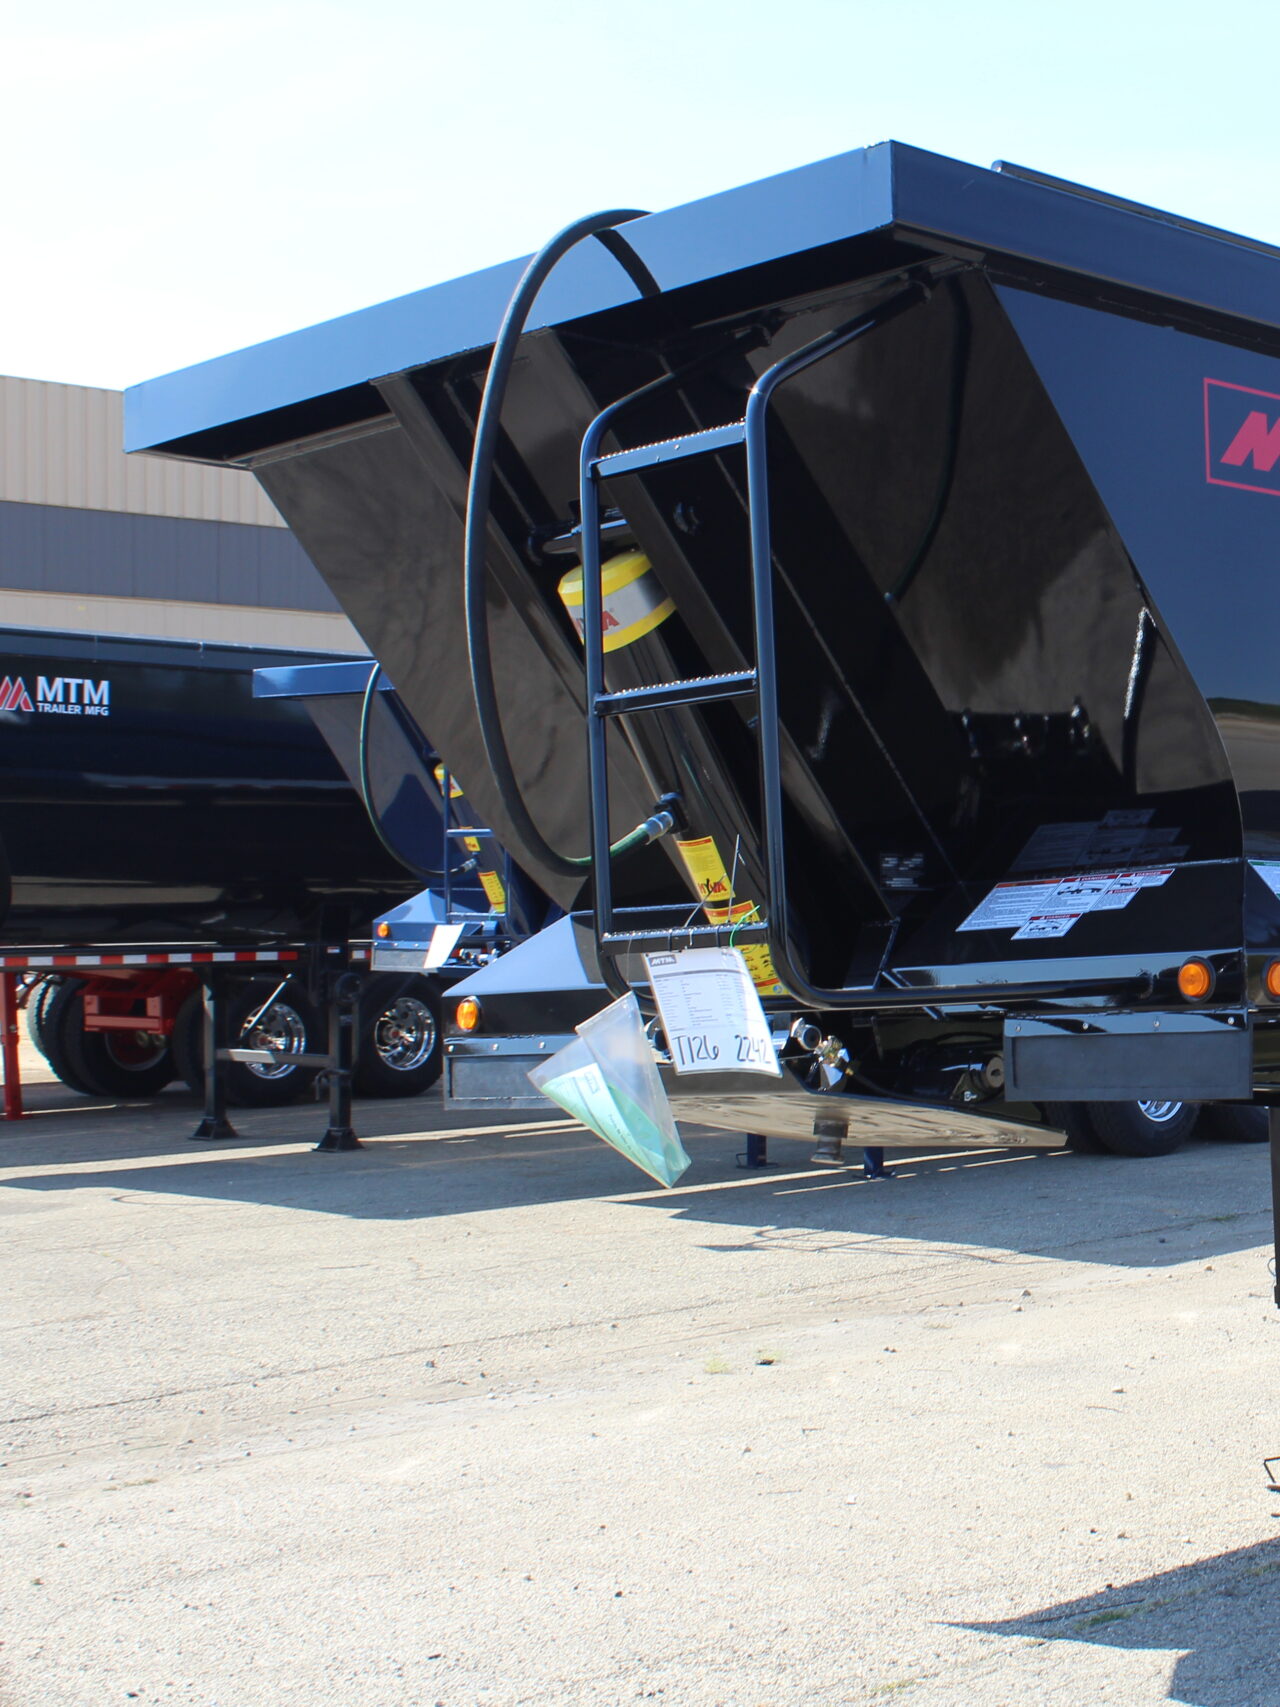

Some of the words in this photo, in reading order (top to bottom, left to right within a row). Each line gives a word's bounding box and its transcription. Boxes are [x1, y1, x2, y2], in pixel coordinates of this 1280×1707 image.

[37, 676, 109, 705] MTM
[37, 703, 82, 714] TRAILER
[85, 706, 109, 716] MFG
[672, 1035, 720, 1065] T126
